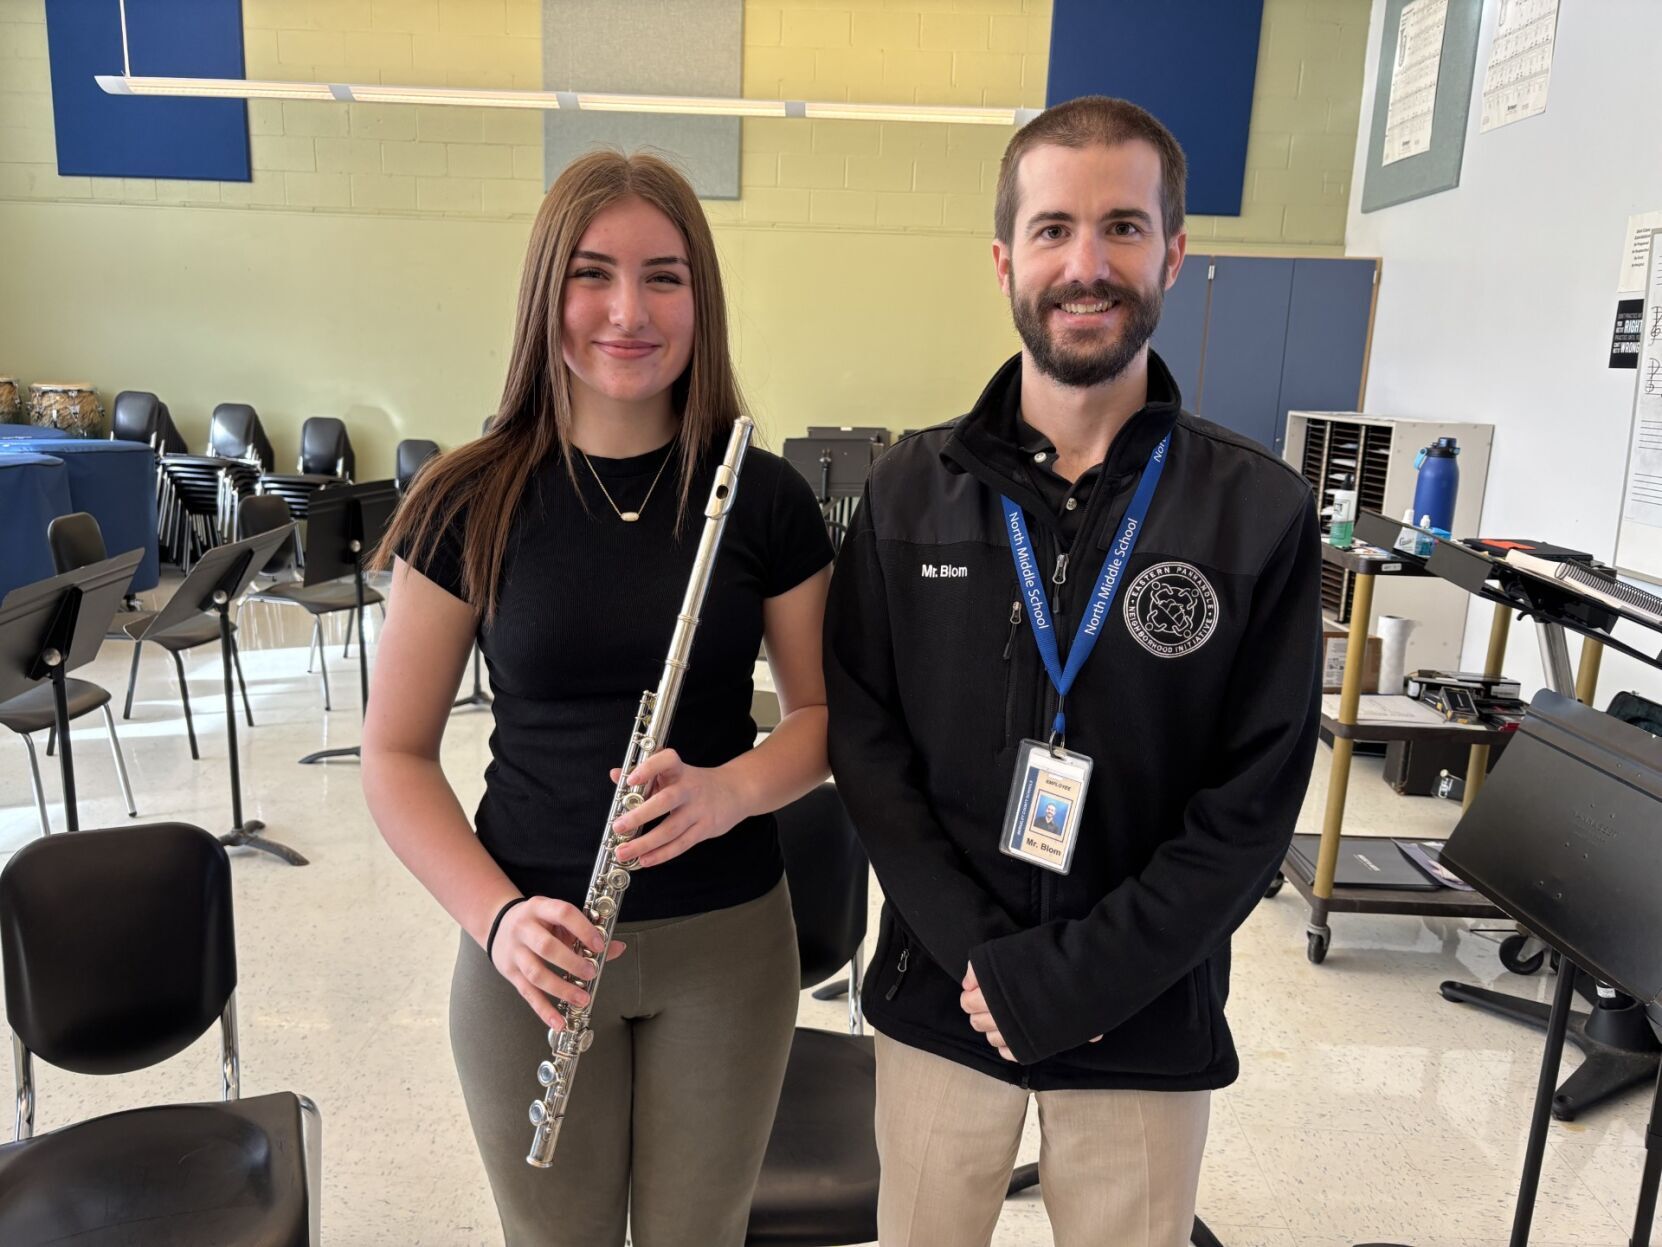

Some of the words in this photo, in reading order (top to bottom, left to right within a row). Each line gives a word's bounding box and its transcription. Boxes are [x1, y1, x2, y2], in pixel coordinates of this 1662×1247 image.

[921, 564, 938, 578] Mr.
[940, 564, 968, 578] Blom
[1009, 511, 1024, 546] North
[1017, 547, 1036, 588] Middle
[1028, 589, 1050, 629] School
[1084, 600, 1107, 635] North
[1098, 558, 1122, 600] Middle
[1115, 518, 1138, 557] School
[1131, 567, 1170, 597] EASTERN
[1176, 566, 1214, 609] PANHANDLE
[1129, 606, 1173, 653] NEIGHBORHOOD
[1175, 618, 1213, 653] INITIATIVE
[1046, 780, 1071, 791] EMPLOYEE
[1026, 838, 1038, 848] Mr.
[1040, 843, 1062, 856] Blom
